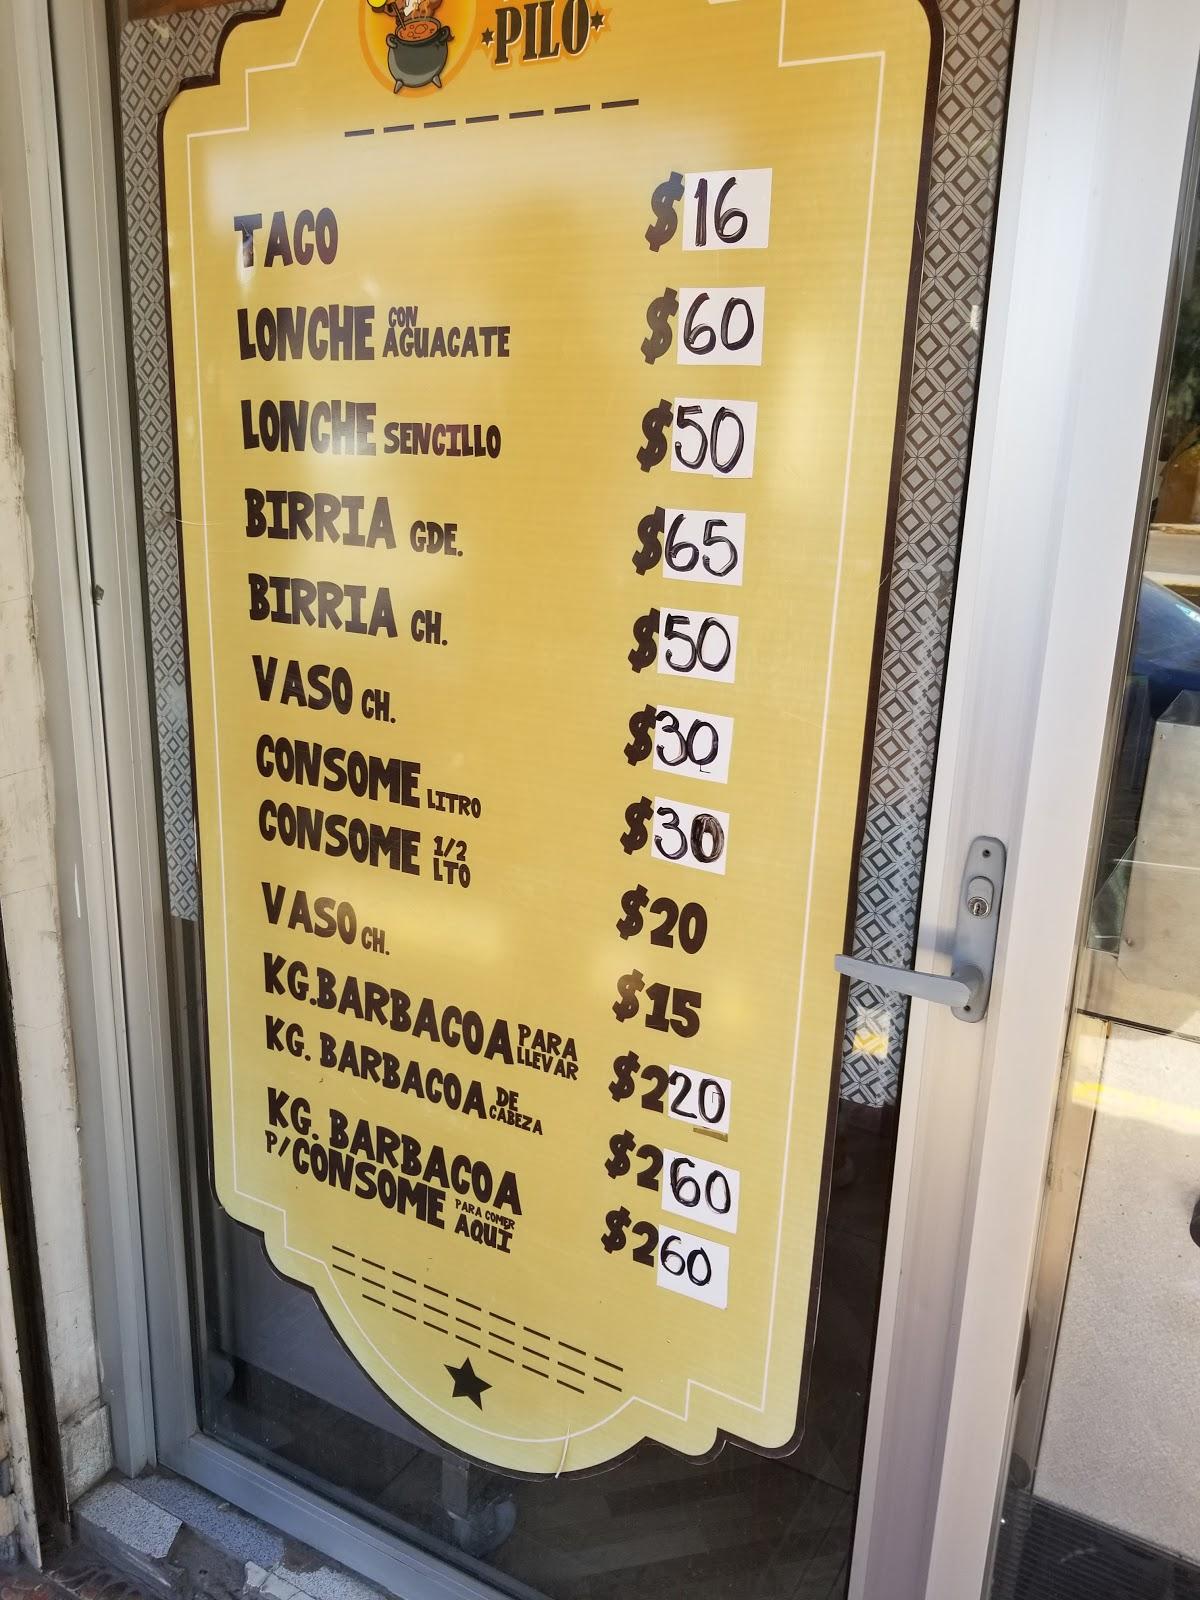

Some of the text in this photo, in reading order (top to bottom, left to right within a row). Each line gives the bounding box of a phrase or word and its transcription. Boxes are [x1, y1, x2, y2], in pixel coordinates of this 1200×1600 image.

[494, 0, 591, 64] PILO
[234, 207, 339, 268] TACO
[236, 304, 375, 362] LONCHE
[382, 326, 511, 359] AGUACATE
[388, 306, 418, 329] CON
[240, 399, 377, 457] LONCHE
[383, 421, 501, 460] SENCILLO
[244, 487, 397, 550] BIRRIA
[409, 520, 464, 558] GDE.
[248, 573, 398, 638] BIRRIA
[410, 609, 448, 646] CH.
[251, 654, 354, 715] VASO
[361, 688, 397, 724] CH.
[255, 734, 421, 809] CONSOME
[426, 788, 482, 820] LITRO
[258, 799, 421, 877] CONSOME
[432, 836, 468, 864] 1/2
[432, 859, 472, 889] LTO
[261, 882, 391, 956] VASO CH.
[616, 883, 709, 955] $20
[611, 968, 703, 1039] $15
[264, 1014, 488, 1120] KG. BARBACOA
[516, 1046, 579, 1082] LLEVAR
[517, 1023, 578, 1063] PARA
[488, 1105, 544, 1137] CABEZA
[494, 1086, 520, 1112] DE
[266, 1086, 523, 1217] KG. BARBACOA
[455, 1198, 516, 1230] PARA COMER
